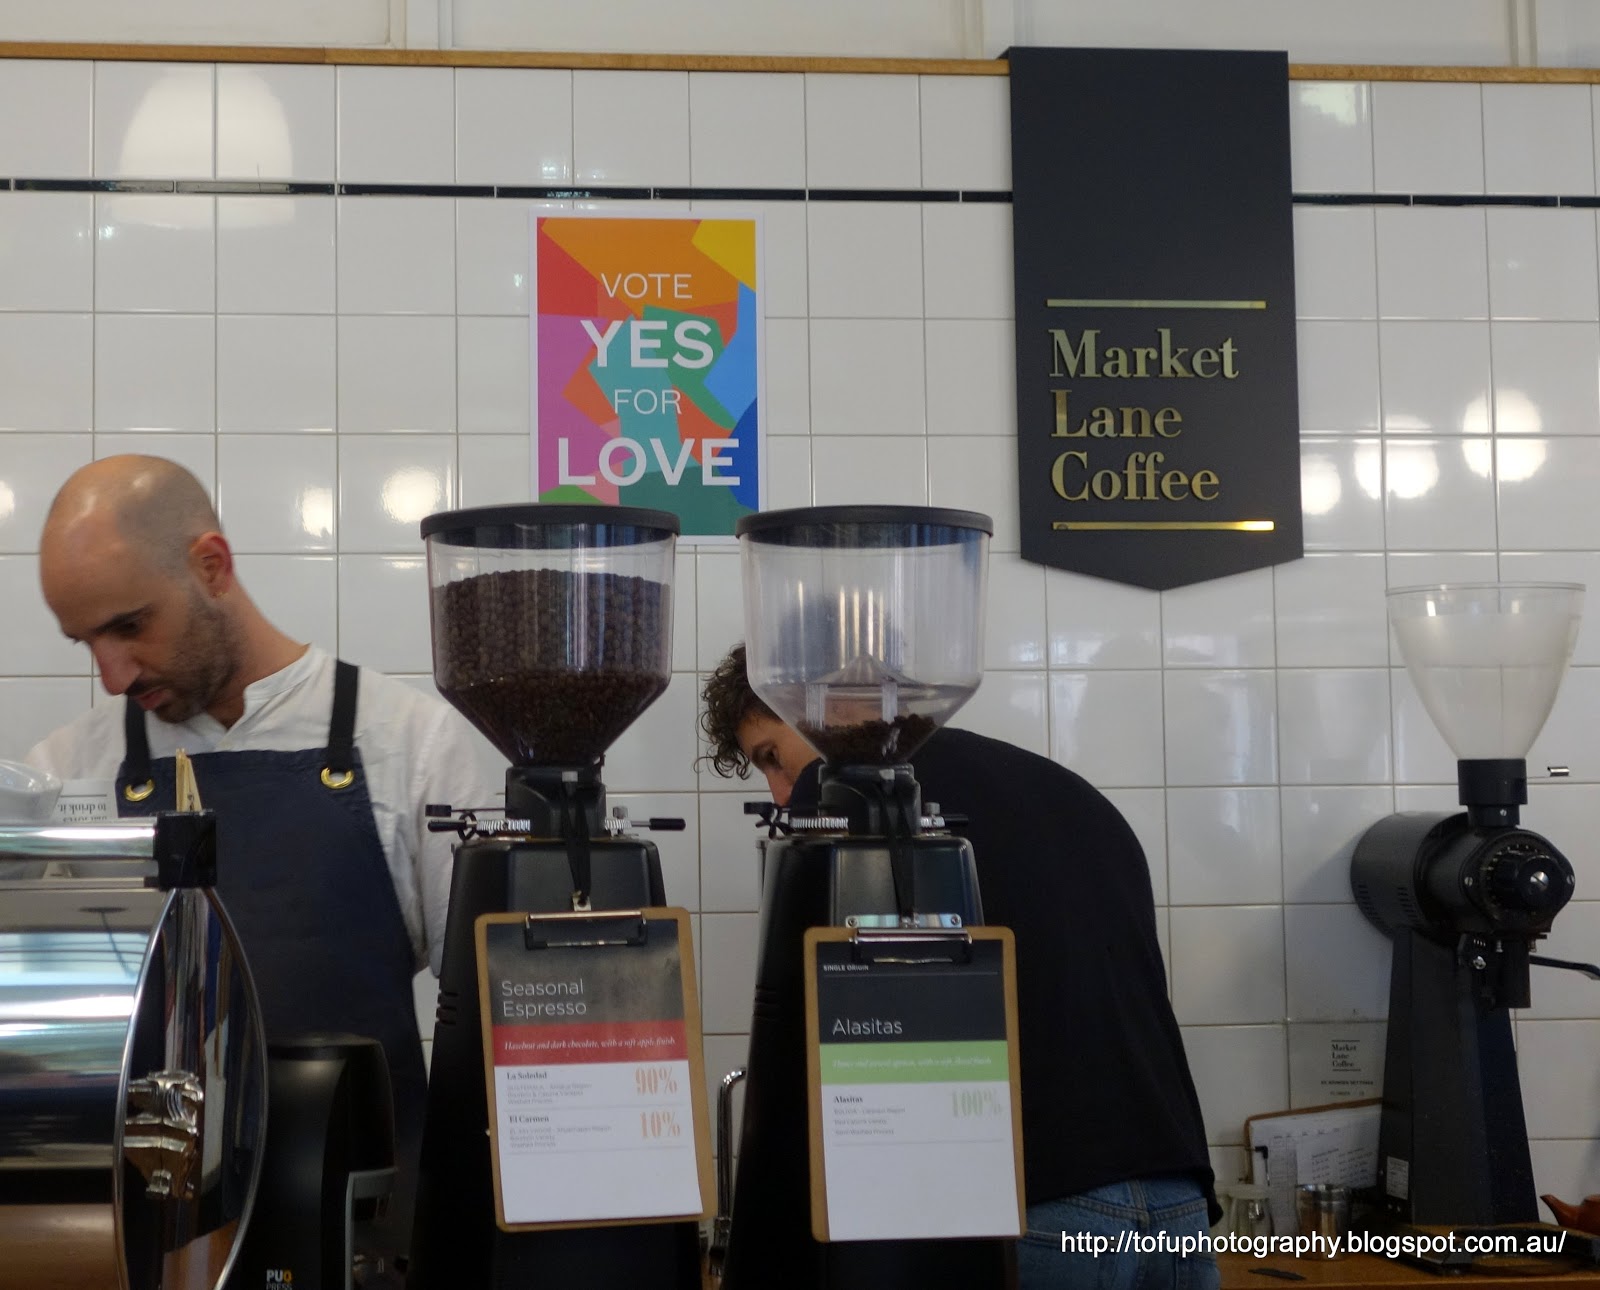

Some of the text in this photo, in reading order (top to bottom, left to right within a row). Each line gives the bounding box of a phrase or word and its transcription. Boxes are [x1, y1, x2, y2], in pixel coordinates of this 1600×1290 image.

[601, 273, 692, 299] VOTE
[580, 320, 714, 369] YES
[1048, 328, 1239, 378] Market
[614, 389, 682, 414] FOR
[1050, 389, 1182, 438] Lane
[558, 437, 740, 486] LOVE
[1051, 451, 1220, 501] Coffee
[69, 803, 95, 815] drink
[98, 803, 106, 812] to
[501, 979, 584, 998] Seasonal
[502, 1000, 587, 1020] Espresso
[832, 1017, 903, 1036] Alasitas
[1332, 1043, 1357, 1051] Market
[506, 1071, 547, 1080] La Soledad
[635, 1066, 678, 1096] 90%
[951, 1088, 1004, 1119] 100%
[519, 1115, 550, 1123] Carmen
[639, 1110, 681, 1139] 10%
